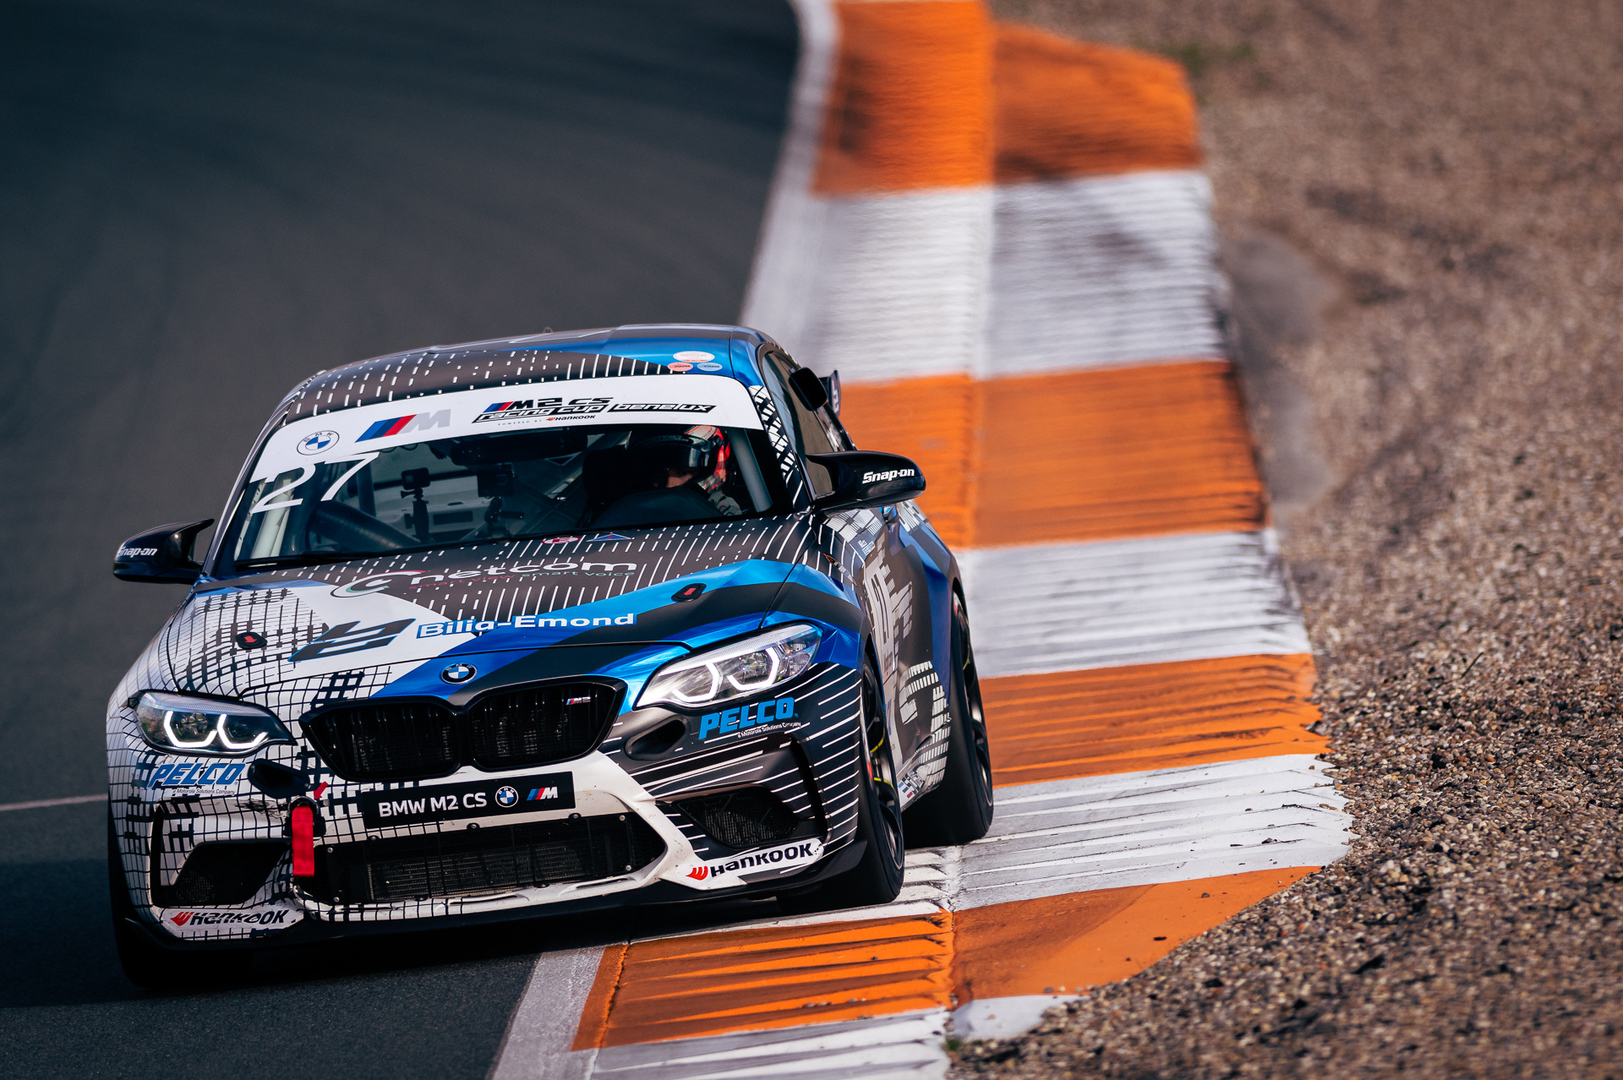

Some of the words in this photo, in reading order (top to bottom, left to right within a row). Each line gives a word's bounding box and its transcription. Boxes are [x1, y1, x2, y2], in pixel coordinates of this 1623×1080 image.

[557, 404, 605, 414] cup
[611, 403, 709, 412] benelux
[250, 452, 380, 514] 27
[862, 468, 915, 484] Snap-on
[117, 546, 158, 558] Snap-on
[411, 562, 637, 585] netcom
[419, 613, 634, 637] Bilia-Emond
[699, 697, 795, 740] PELCO
[148, 763, 246, 787] PELCO
[378, 798, 426, 817] BMW
[430, 795, 459, 812] M2
[462, 792, 487, 808] CS
